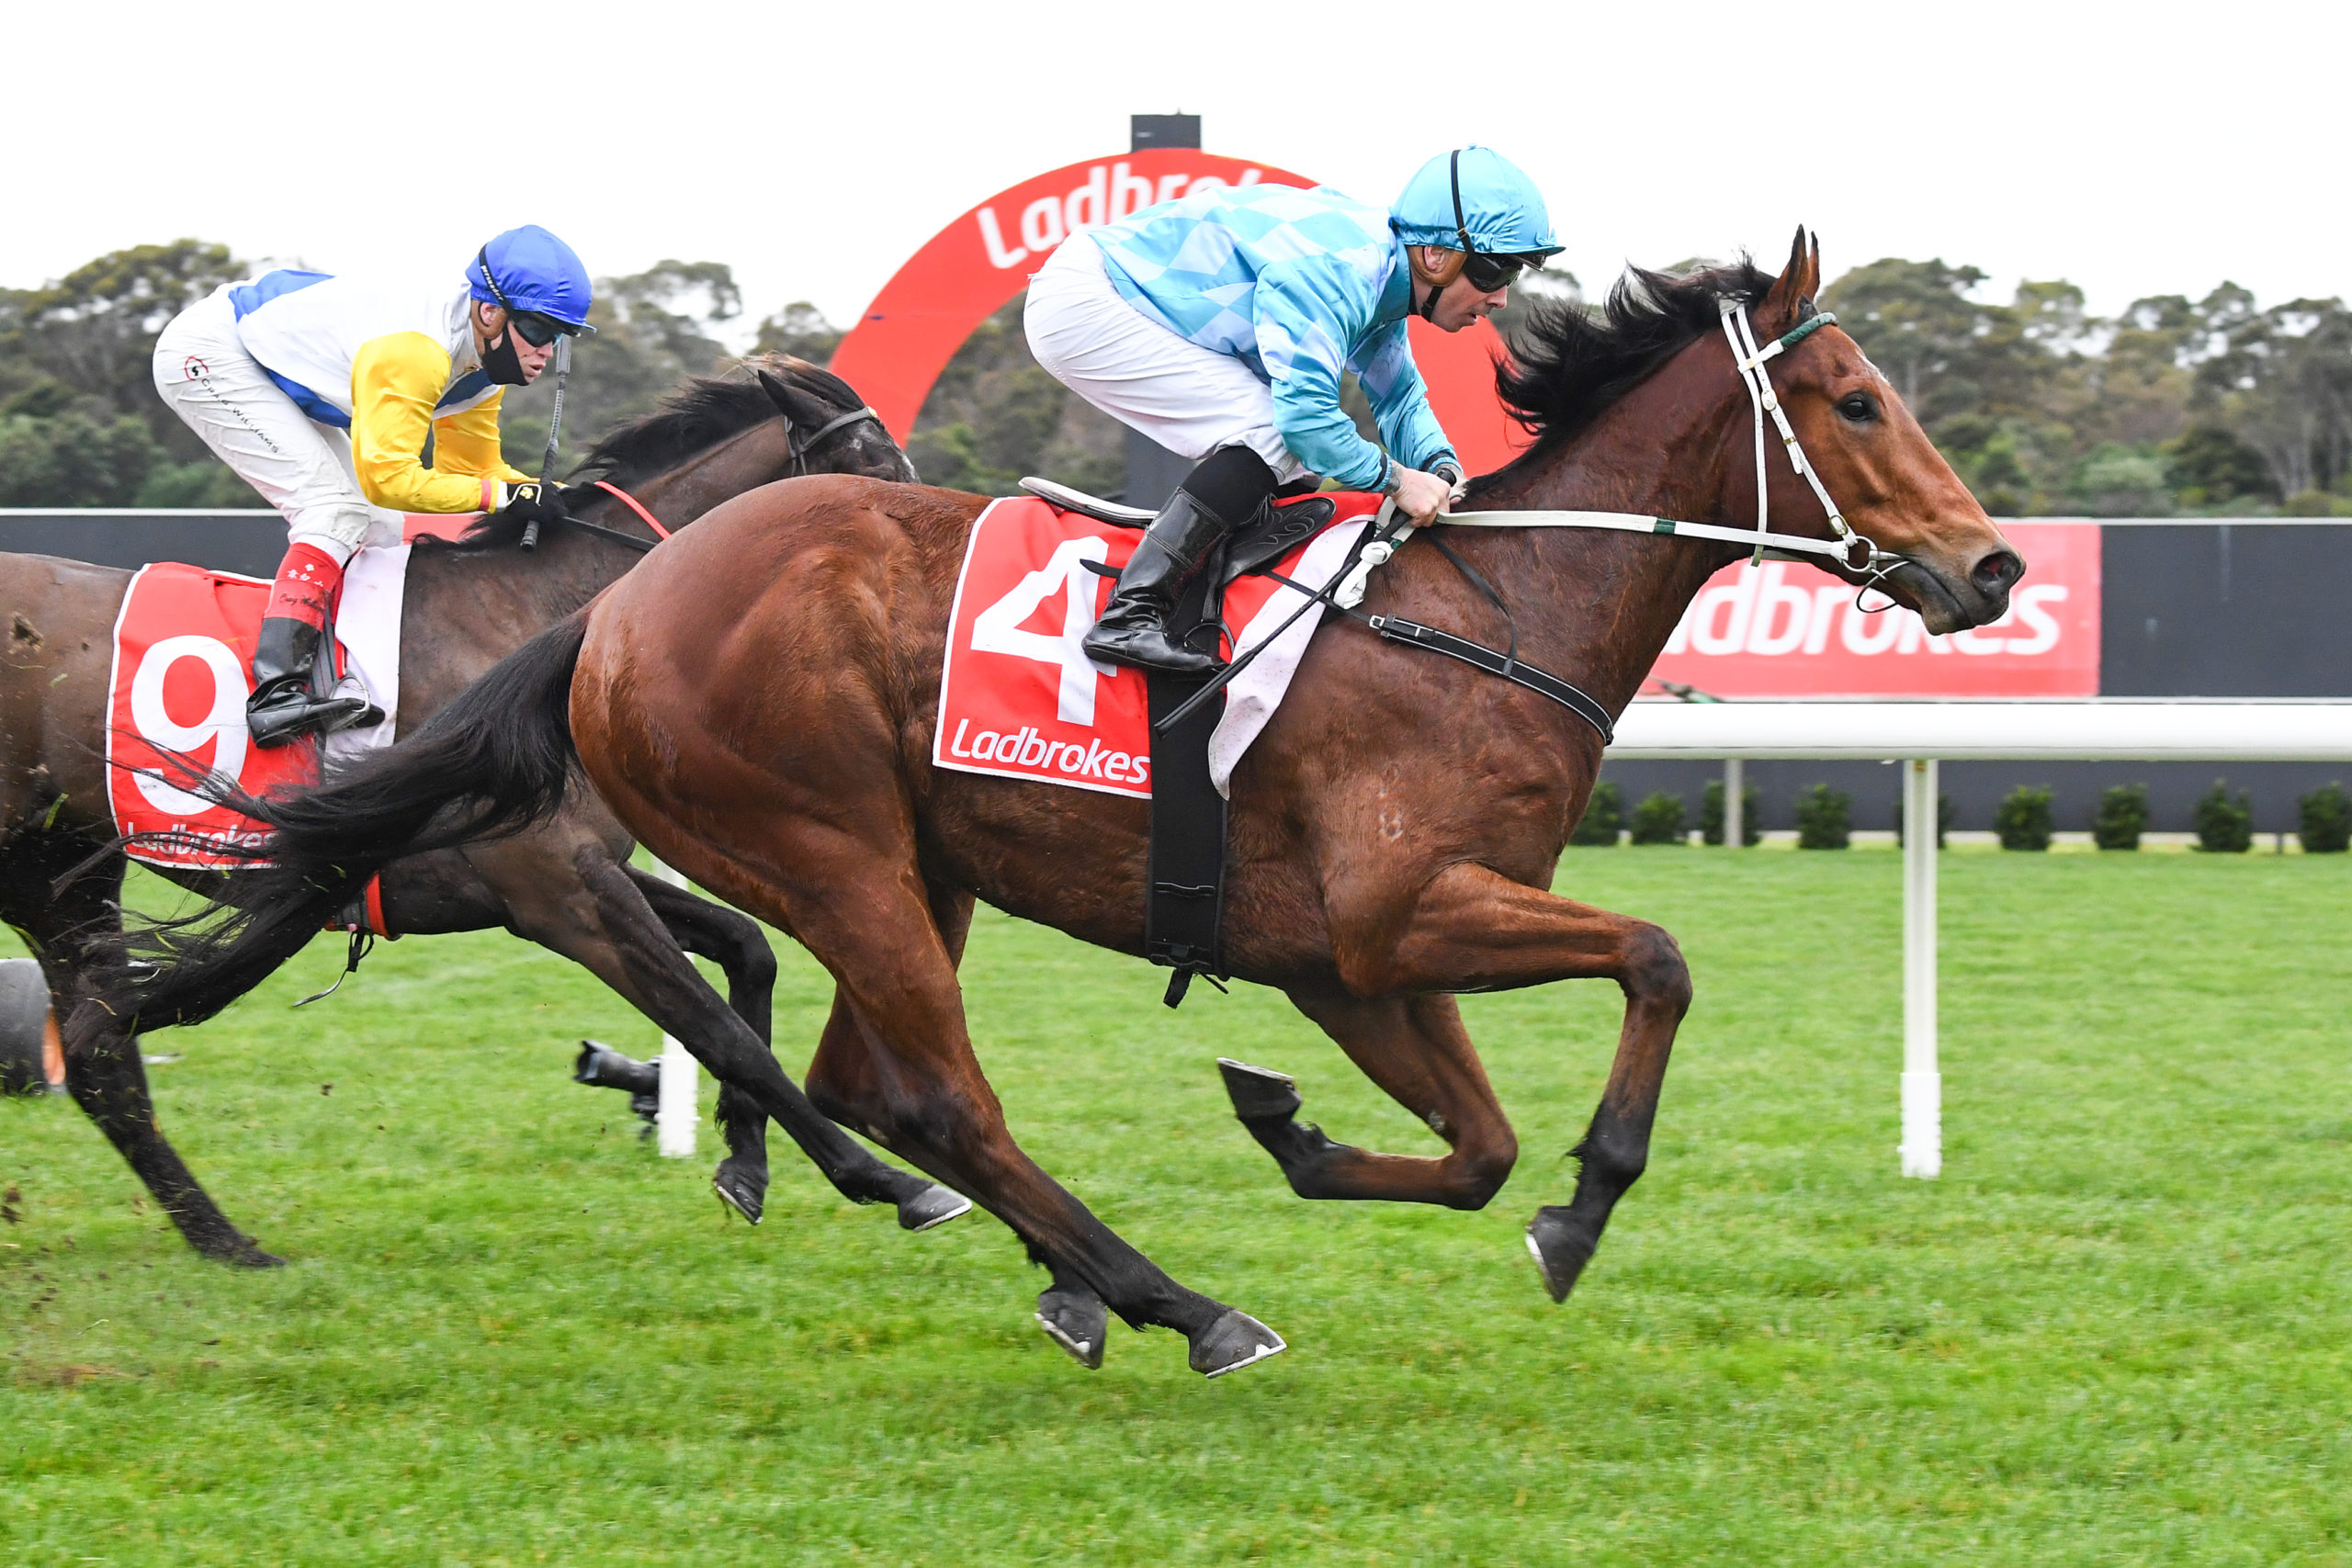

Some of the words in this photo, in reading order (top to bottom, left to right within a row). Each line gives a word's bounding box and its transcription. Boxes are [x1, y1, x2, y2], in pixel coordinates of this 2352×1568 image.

[977, 162, 1263, 269] Ladbr
[201, 378, 229, 405] CRAG
[970, 536, 1117, 727] 4
[130, 635, 250, 816] 9
[951, 718, 1151, 784] Ladbrokes
